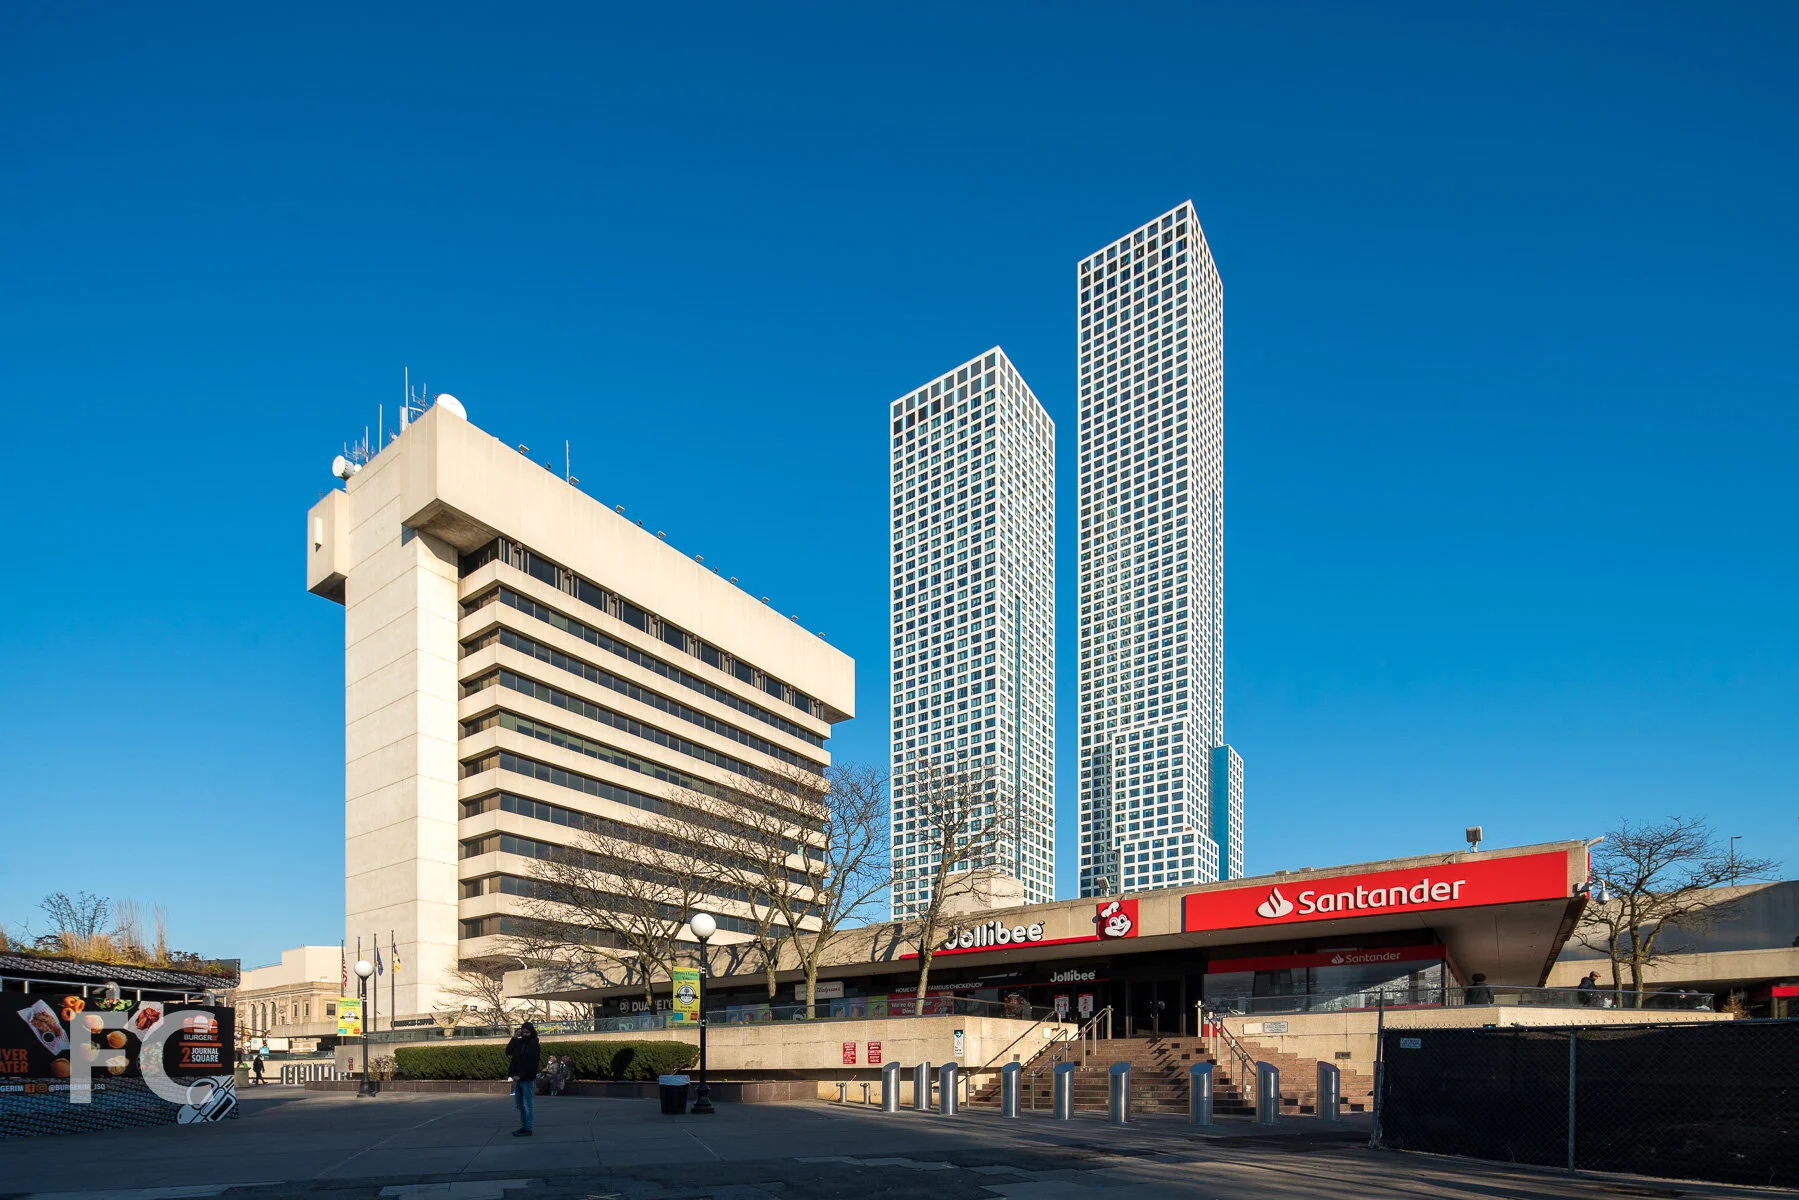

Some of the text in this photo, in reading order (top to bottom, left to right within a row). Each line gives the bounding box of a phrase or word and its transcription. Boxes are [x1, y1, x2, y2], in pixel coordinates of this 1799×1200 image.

[1299, 878, 1466, 915] Santander
[945, 920, 1043, 950] Jollibee
[1345, 952, 1401, 963] Santander
[1050, 969, 1096, 983] Jollibee
[181, 1047, 220, 1063] 2 JOURNAL
[191, 1054, 220, 1063] SQUARE
